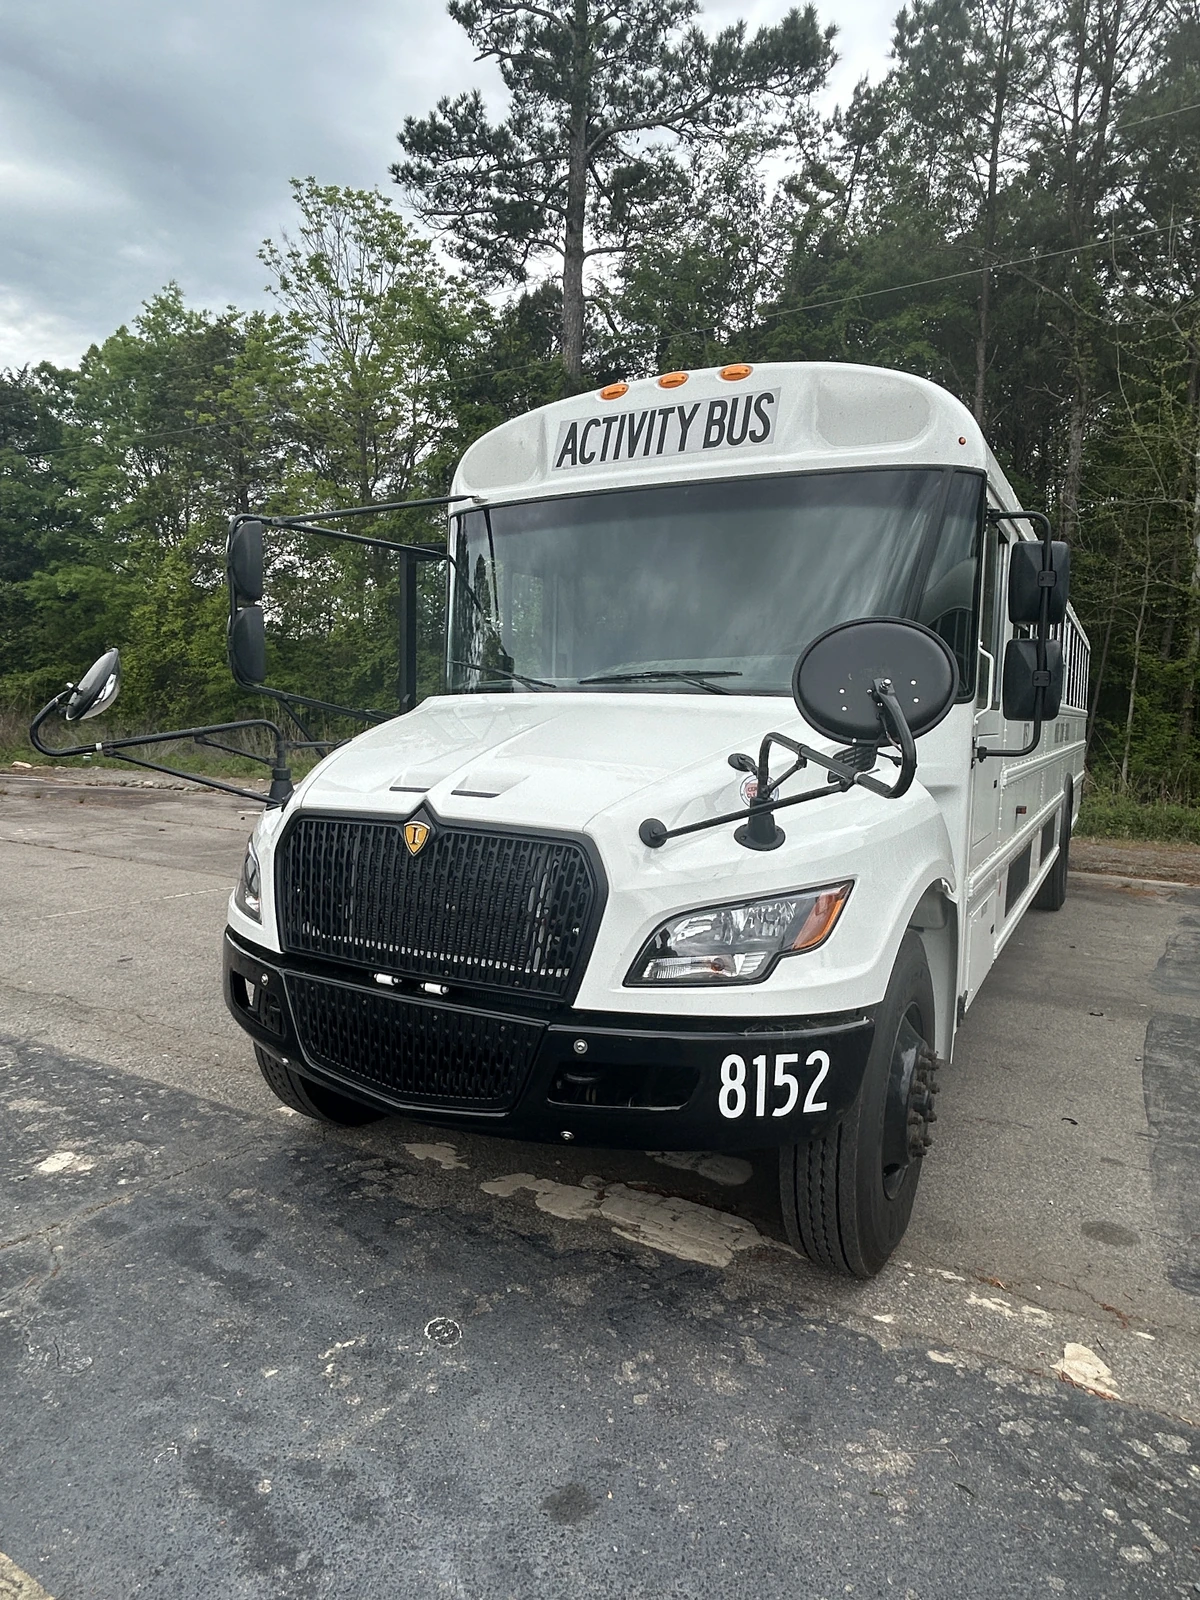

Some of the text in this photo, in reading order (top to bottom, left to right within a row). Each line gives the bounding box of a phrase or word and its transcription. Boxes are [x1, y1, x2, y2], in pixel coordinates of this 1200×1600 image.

[555, 392, 775, 468] ACTIVITY BUS
[718, 1050, 830, 1119] 8152
